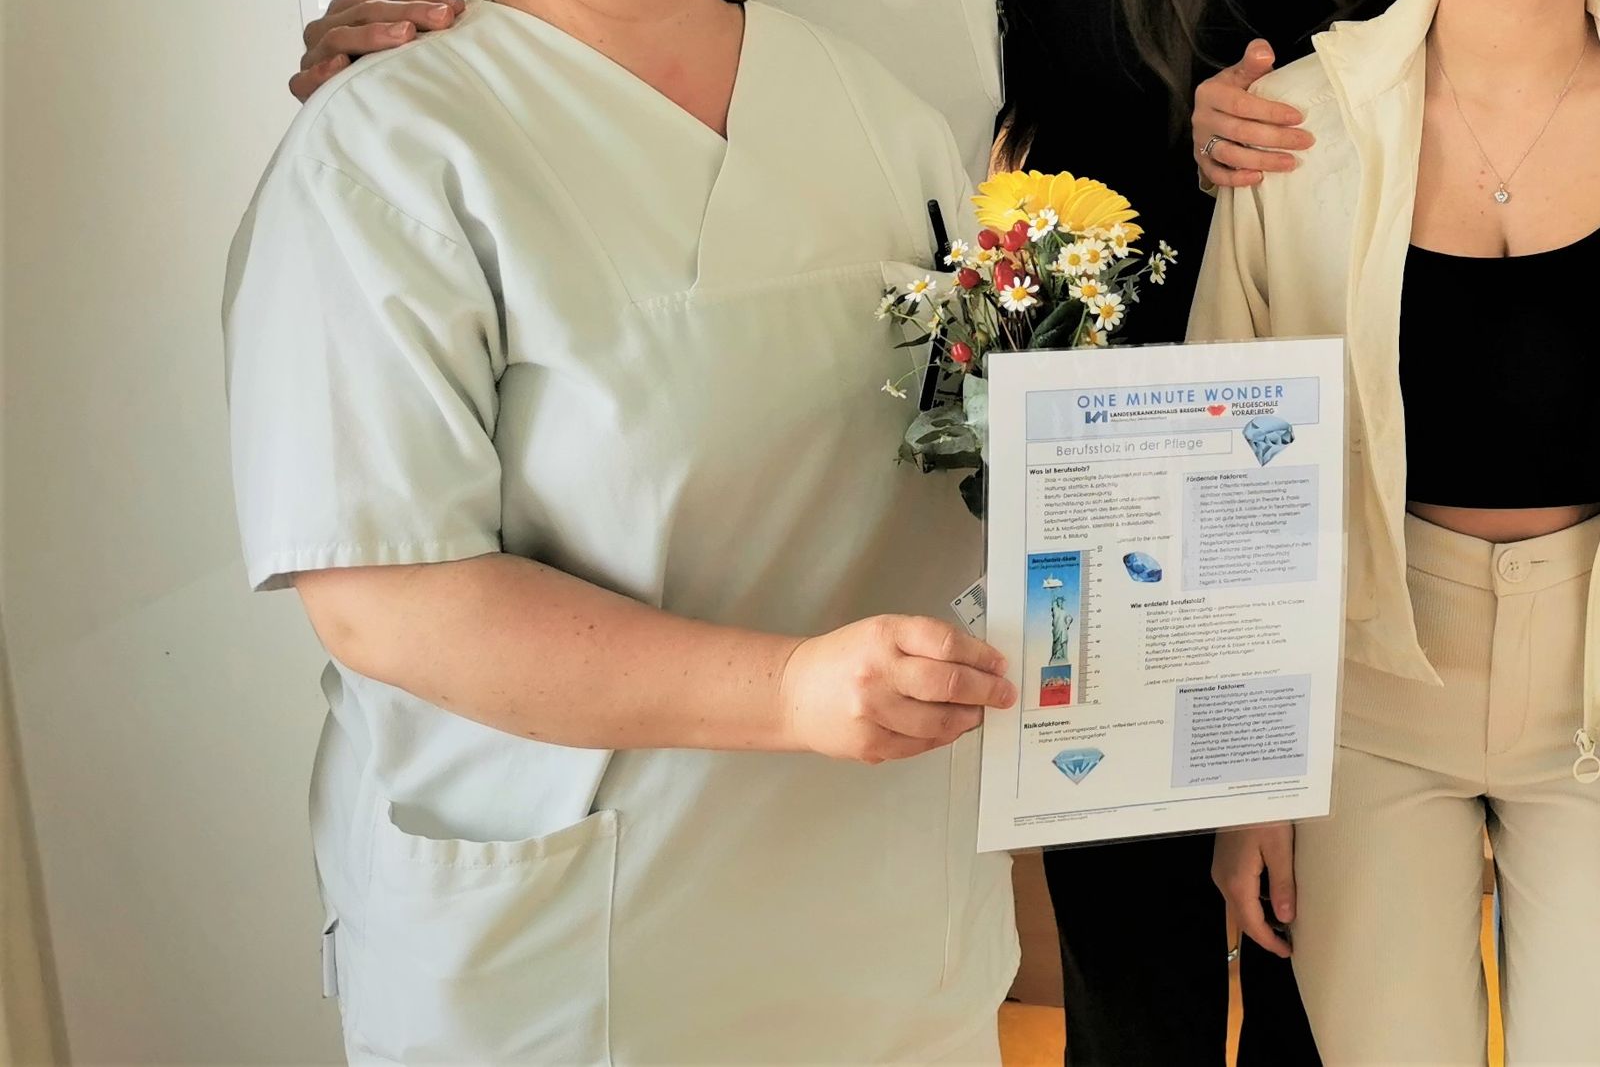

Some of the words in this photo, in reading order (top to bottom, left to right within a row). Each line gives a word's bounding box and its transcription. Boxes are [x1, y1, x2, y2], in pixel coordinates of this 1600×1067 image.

[1077, 394, 1117, 408] ONE
[1126, 390, 1195, 406] MINUTE
[1205, 385, 1284, 401] WONDER
[1231, 400, 1278, 409] PFLEGESCHULE
[1231, 408, 1274, 416] VORARLBERG
[1056, 443, 1121, 456] Berufsstolz
[1125, 441, 1135, 452] in
[1139, 440, 1160, 451] der
[1164, 438, 1203, 450] Pflege
